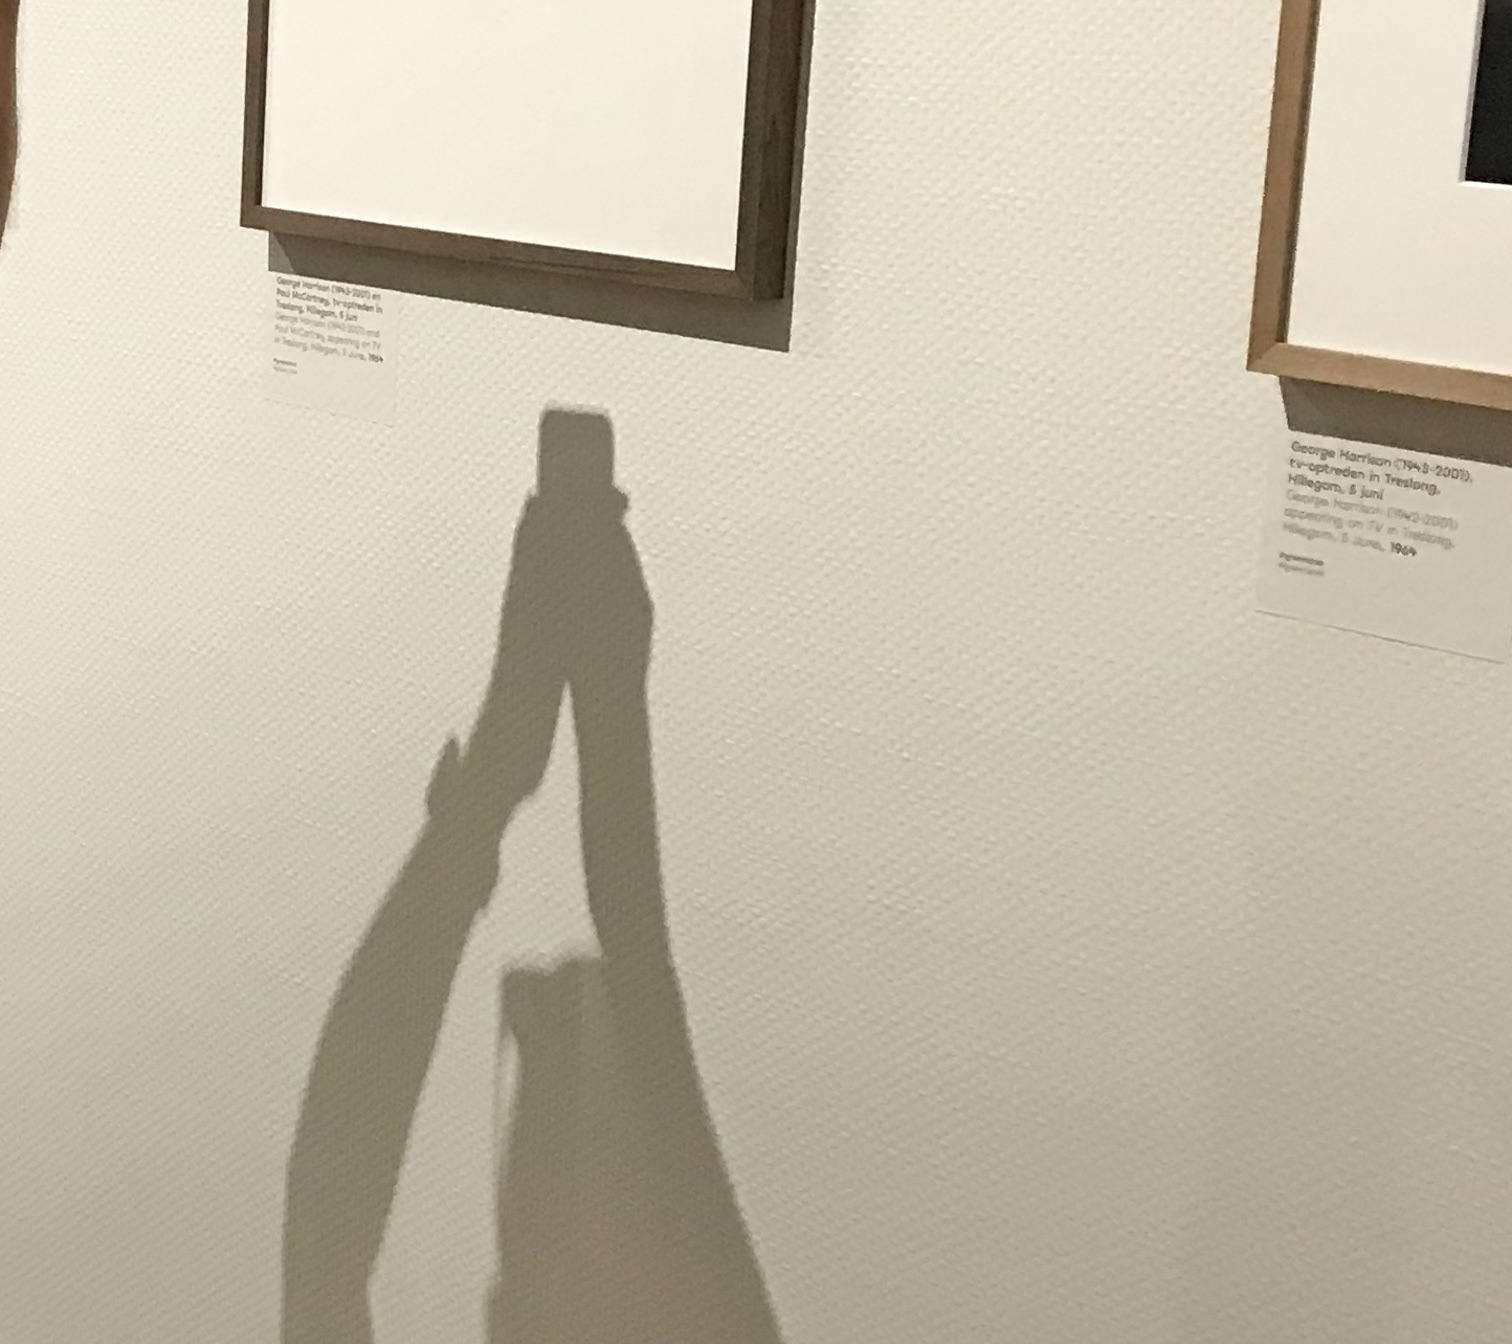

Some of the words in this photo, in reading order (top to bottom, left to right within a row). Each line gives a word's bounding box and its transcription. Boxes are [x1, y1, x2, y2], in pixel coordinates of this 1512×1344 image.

[1291, 441, 1335, 460] George
[1340, 450, 1392, 468] Harrison
[1369, 470, 1380, 483] in
[1360, 485, 1385, 500] juni
